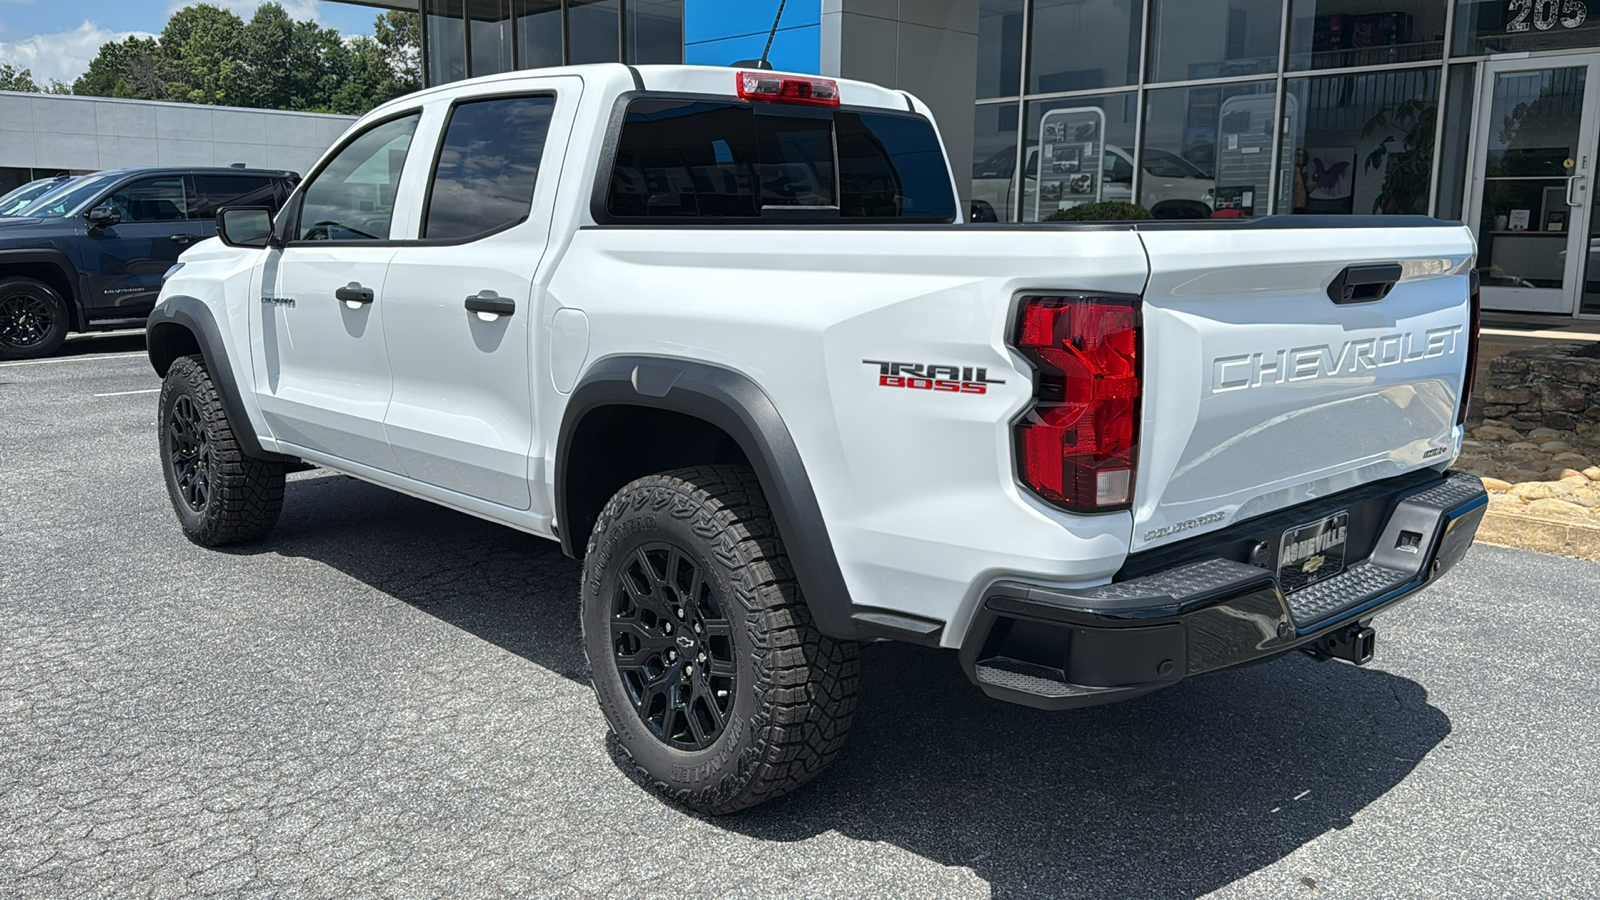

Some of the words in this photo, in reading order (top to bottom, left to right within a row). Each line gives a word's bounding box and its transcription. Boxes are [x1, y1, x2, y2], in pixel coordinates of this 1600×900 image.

[1506, 0, 1587, 33] 205
[862, 359, 1006, 385] TRAIL
[1212, 324, 1463, 393] CHEVROLET
[879, 375, 987, 394] BOSS
[1144, 511, 1226, 541] COLORADO
[1281, 526, 1346, 566] ASHEVILLE
